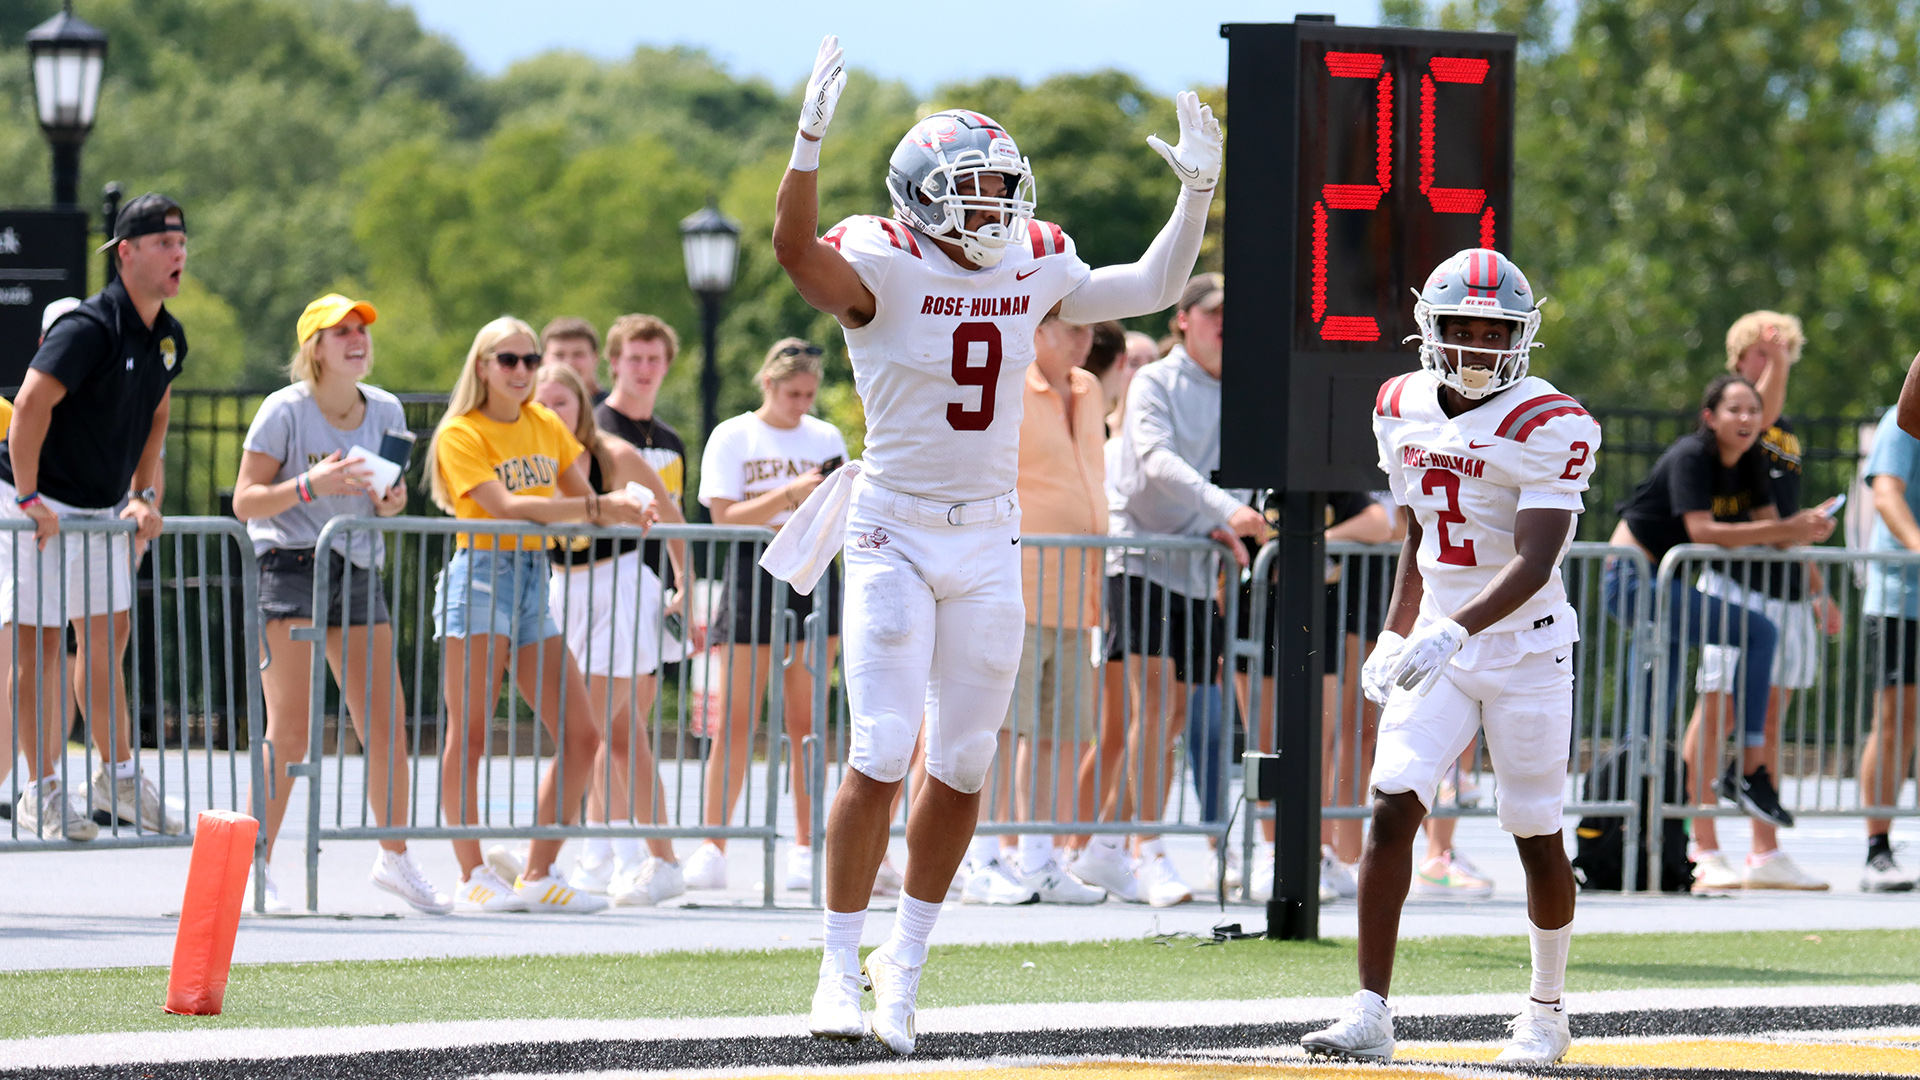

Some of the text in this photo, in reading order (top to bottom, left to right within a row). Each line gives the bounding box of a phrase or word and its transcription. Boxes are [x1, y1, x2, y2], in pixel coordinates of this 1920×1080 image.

[1311, 51, 1496, 342] 25
[921, 295, 1031, 317] ROSE-HULMAN
[946, 322, 1003, 431] 9
[743, 458, 822, 484] DEPA
[1403, 445, 1486, 479] ROSE-HULMAN
[1559, 441, 1590, 480] 2
[1421, 468, 1478, 567] 2
